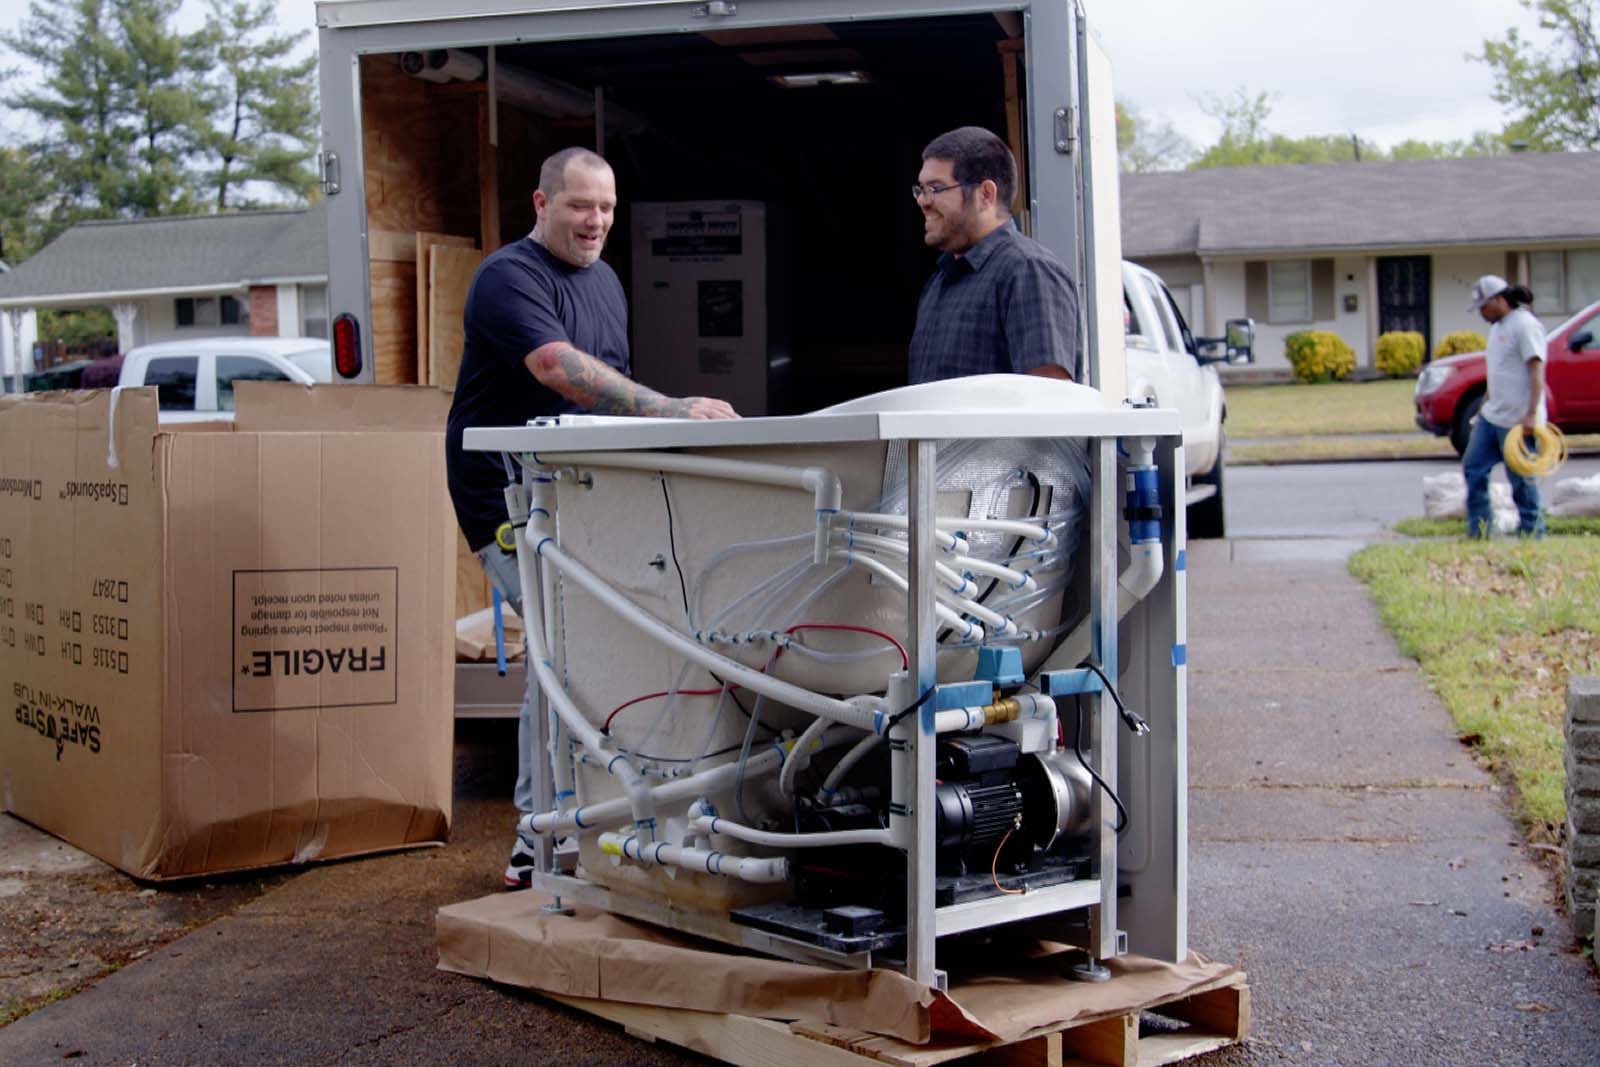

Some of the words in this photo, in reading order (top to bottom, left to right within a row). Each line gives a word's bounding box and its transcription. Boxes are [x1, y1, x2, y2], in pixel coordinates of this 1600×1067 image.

[92, 578, 116, 599] 2847
[290, 592, 317, 603] upon
[318, 593, 346, 605] noted
[349, 592, 380, 603] unless
[251, 609, 292, 621] damage
[294, 610, 307, 621] for
[362, 607, 379, 619] Not
[92, 614, 116, 636] 3153
[241, 624, 278, 638] signing
[280, 625, 312, 636] before
[314, 622, 350, 635] inspect
[92, 648, 116, 669] 5116
[13, 681, 38, 705] TUB
[40, 690, 101, 725] WALK-IN
[15, 703, 46, 736] STEP
[60, 717, 101, 754] SAFE
